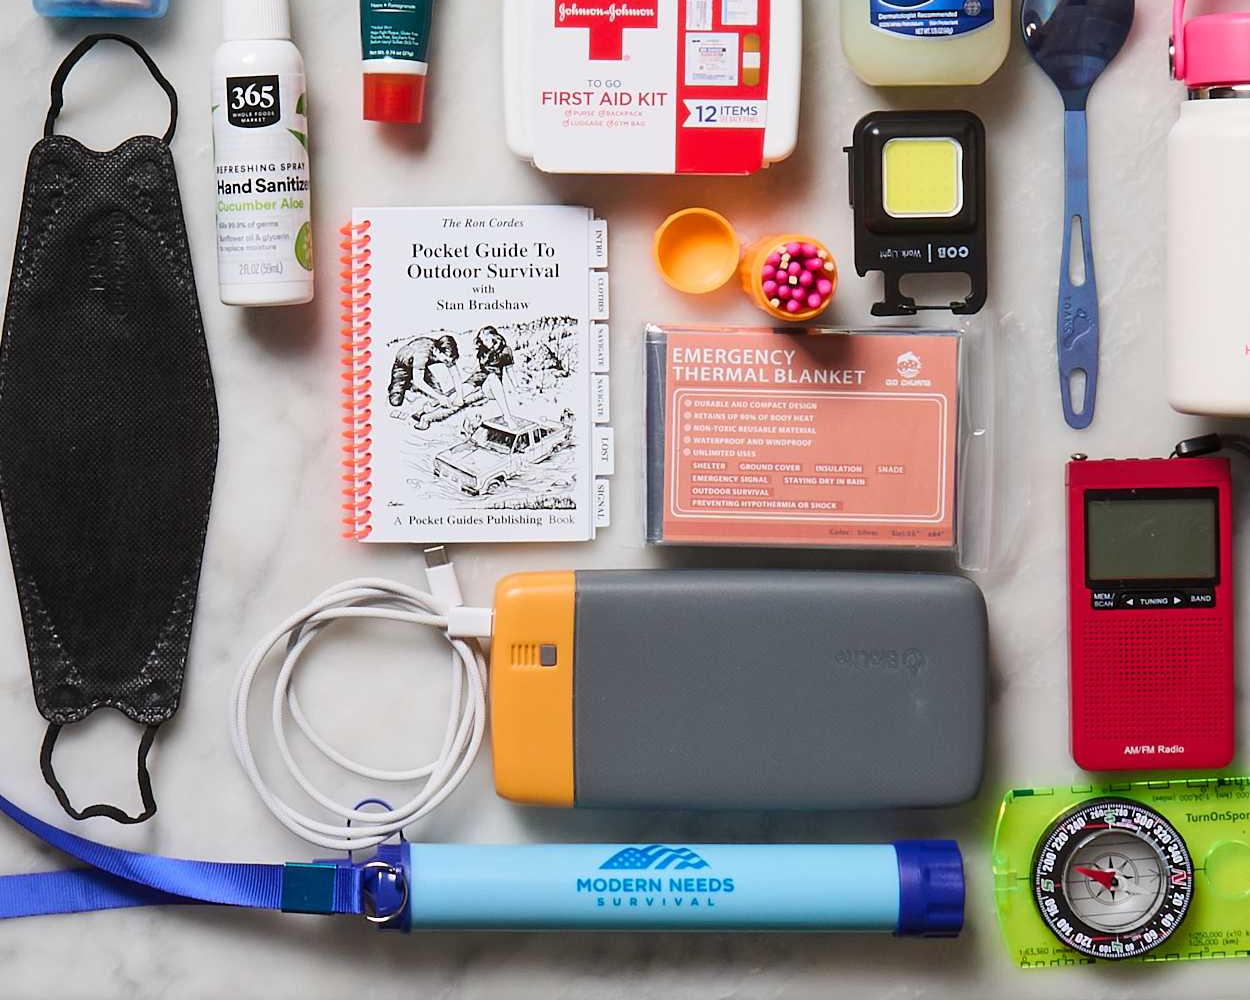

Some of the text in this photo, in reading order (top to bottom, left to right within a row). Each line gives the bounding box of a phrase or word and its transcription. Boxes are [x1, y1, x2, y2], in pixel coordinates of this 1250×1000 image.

[231, 83, 275, 110] 365
[542, 91, 668, 107] FIRST AID KIT
[695, 105, 759, 123] 12 ITEMS
[280, 162, 306, 172] SPRAY
[217, 178, 252, 195] Hand
[442, 217, 525, 229] The Ron Cordes
[412, 241, 556, 260] Pocket Guide To
[937, 246, 970, 259] COB
[407, 263, 561, 280] Outdoor Survival
[472, 284, 496, 295] with
[436, 299, 531, 312] Stan Bradshaw
[672, 348, 797, 366] EMERGENCY
[672, 366, 769, 384] THERMAL
[774, 368, 867, 385] BLANKET
[600, 437, 610, 463] LOST
[692, 448, 736, 457] UNLIMITED
[692, 461, 726, 470] SHELTER
[739, 462, 774, 471] GROUND
[774, 462, 801, 471] COVER
[815, 464, 863, 473] INSULATION
[692, 487, 769, 496] OUTDOOR SURVIVAL
[1093, 600, 1114, 608] SCAN
[1140, 597, 1169, 606] TUNING
[1124, 745, 1185, 755] AM/FM Radio
[1066, 818, 1087, 836] 240
[1153, 824, 1172, 844] 320
[576, 877, 736, 894] MODERN NEEDS
[596, 898, 715, 907] SURVIVAL
[1172, 892, 1185, 908] 20
